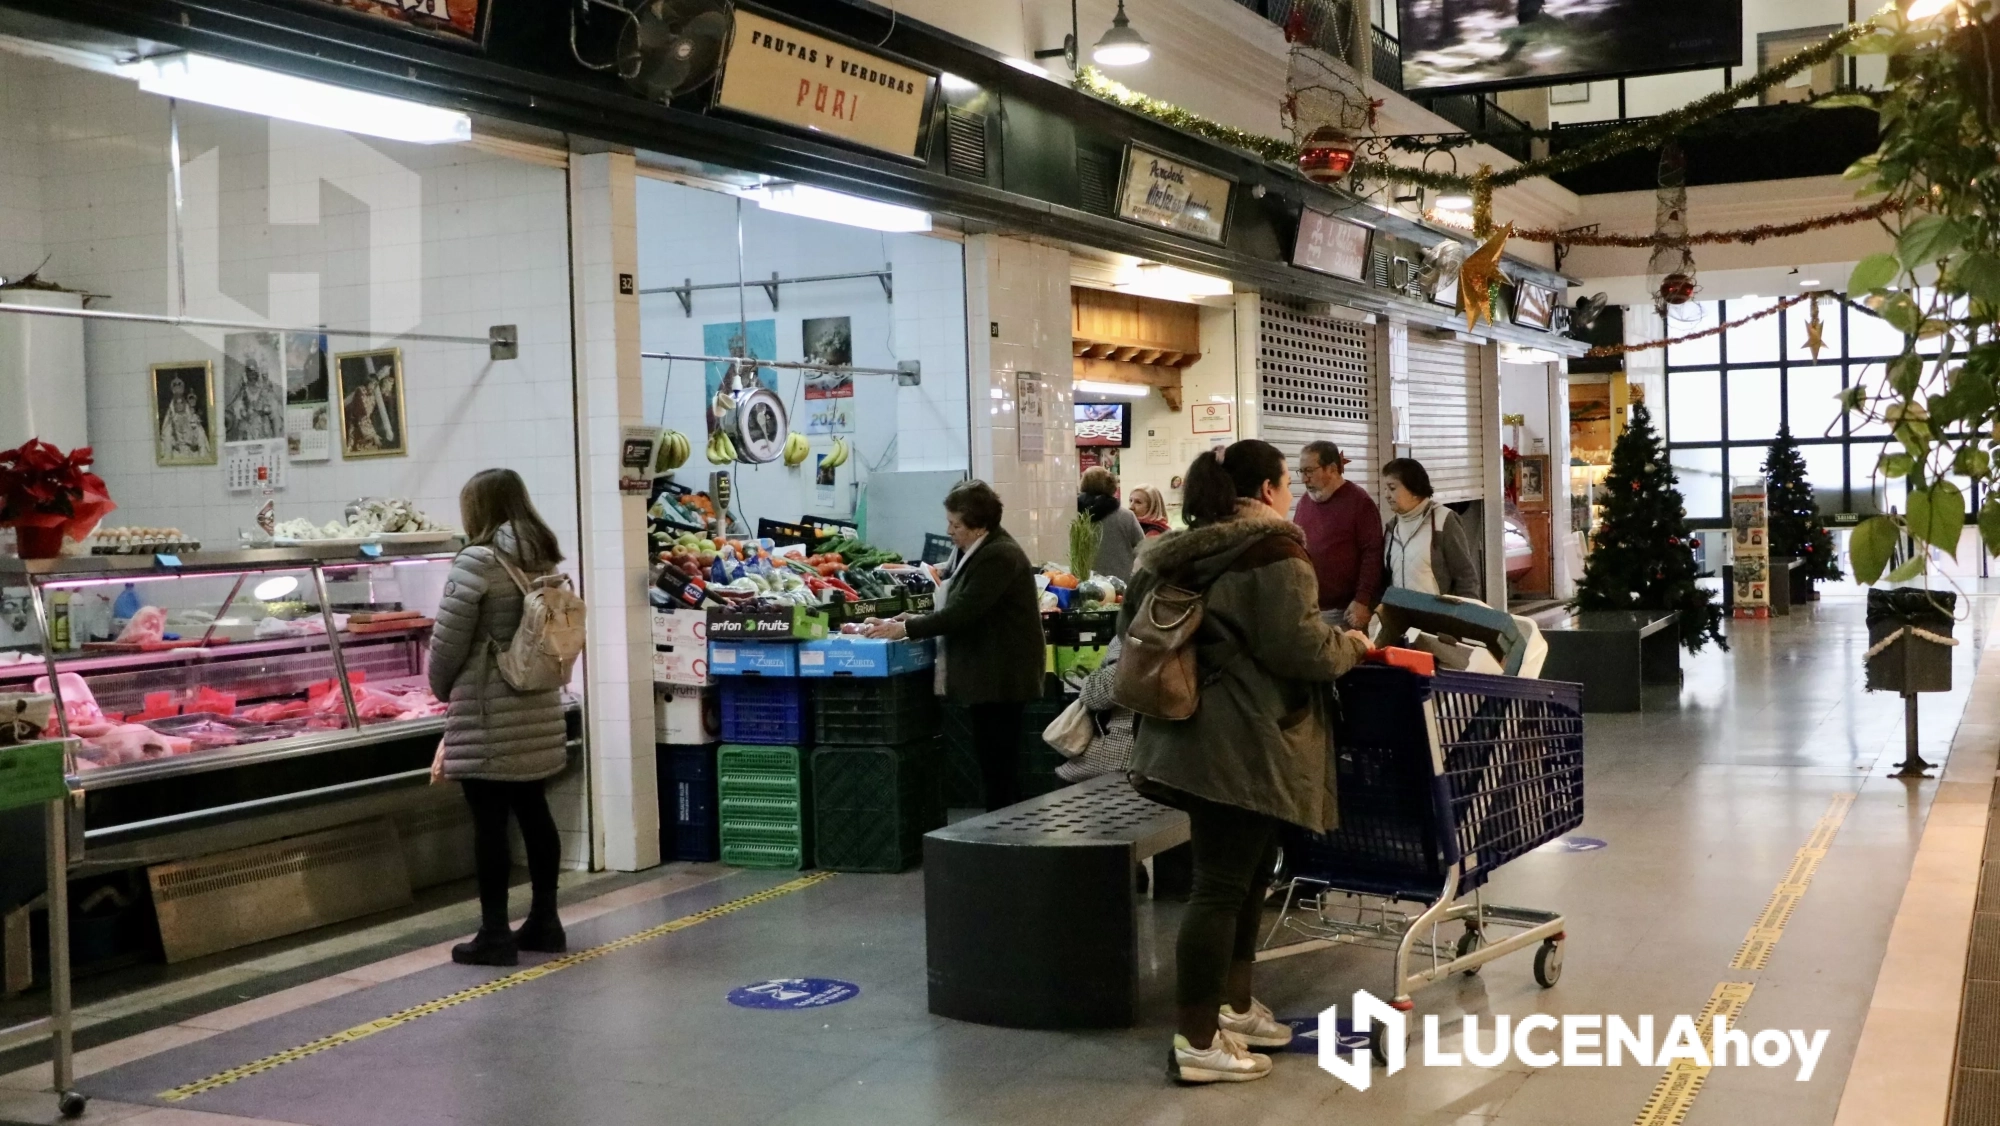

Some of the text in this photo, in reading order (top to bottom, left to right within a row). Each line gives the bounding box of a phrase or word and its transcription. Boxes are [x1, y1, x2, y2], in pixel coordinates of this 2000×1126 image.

[752, 31, 915, 95] FRUTAS Y VERDURAS
[621, 277, 633, 290] 32
[991, 325, 998, 335] 31
[810, 413, 847, 428] 2024
[684, 585, 702, 599] KANZI
[710, 620, 790, 631] arfon fruits
